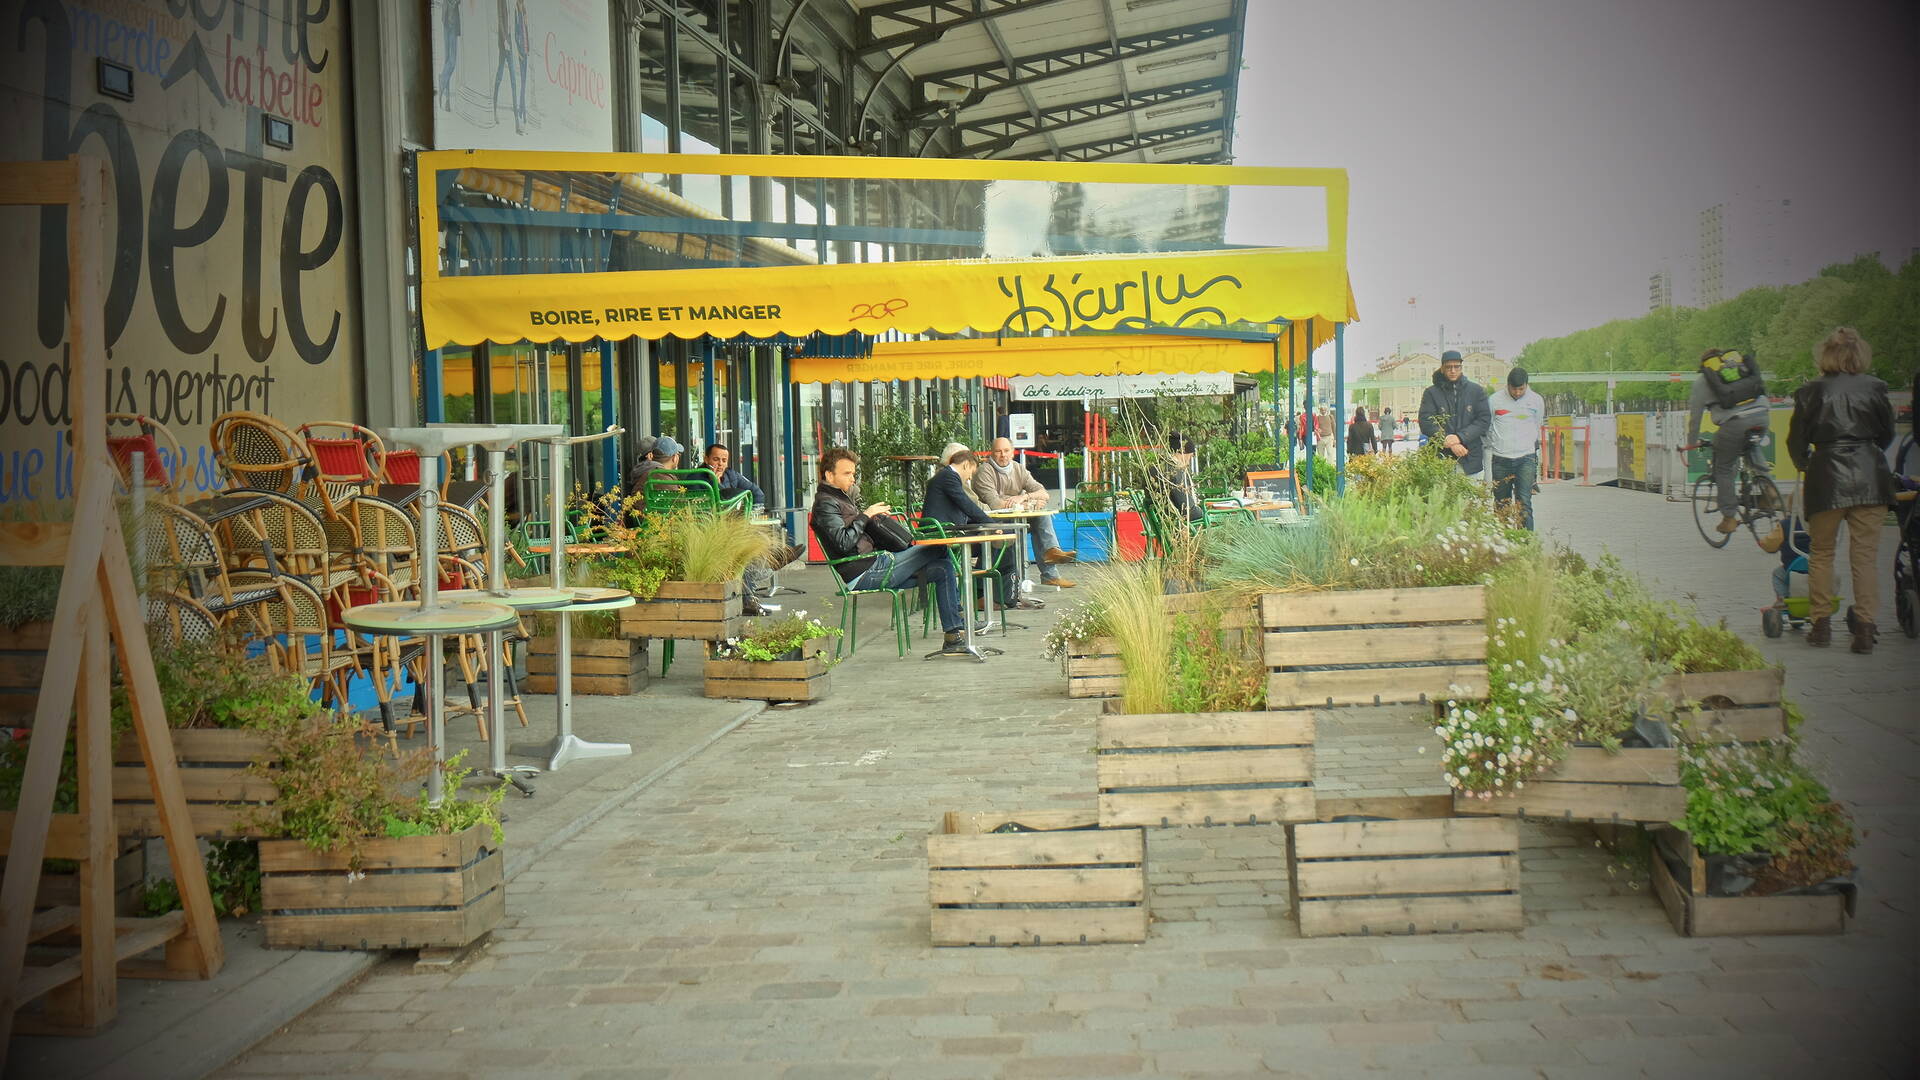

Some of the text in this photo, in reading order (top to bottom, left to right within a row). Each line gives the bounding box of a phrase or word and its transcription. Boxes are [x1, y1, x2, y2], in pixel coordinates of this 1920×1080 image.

[68, 8, 173, 79] merde
[544, 31, 605, 109] Caprice
[225, 33, 255, 106] la
[257, 46, 323, 127] belle
[530, 304, 782, 327] BOIRE, RIRE ET MANGER
[0, 448, 44, 503] ue
